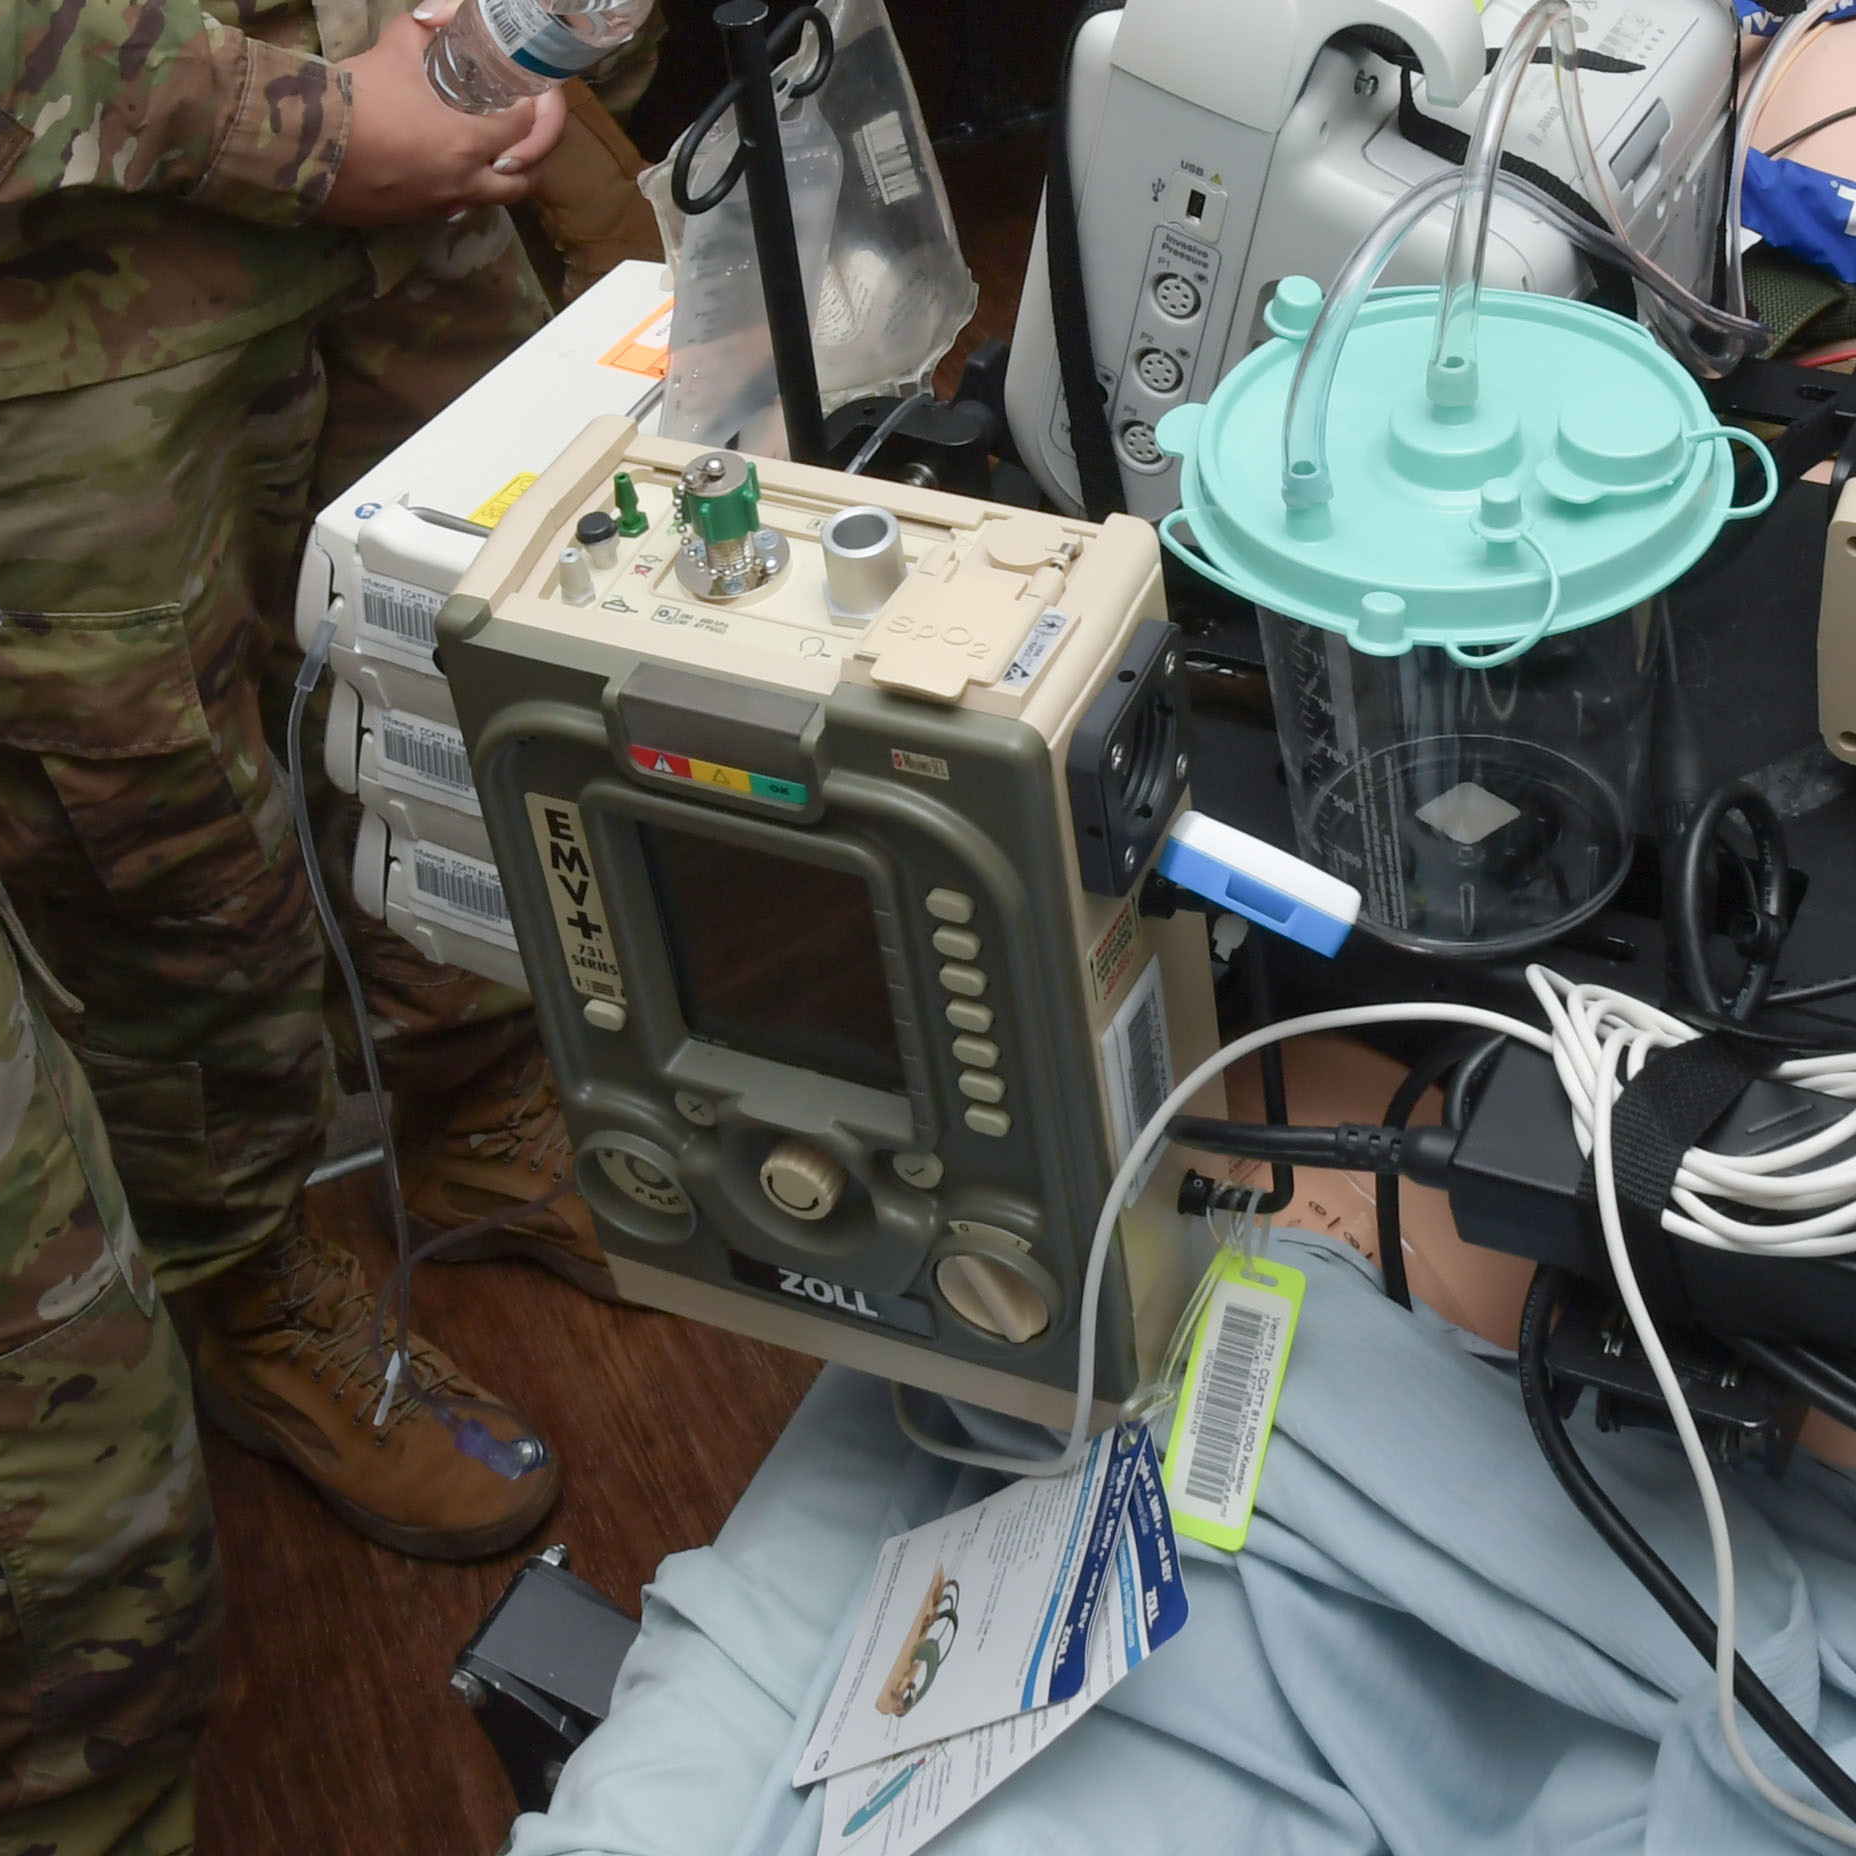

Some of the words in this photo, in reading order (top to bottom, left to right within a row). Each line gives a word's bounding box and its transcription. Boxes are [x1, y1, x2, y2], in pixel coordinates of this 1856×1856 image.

[1179, 159, 1204, 177] USB
[1160, 241, 1210, 270] Pressure
[1164, 232, 1210, 260] Invasive
[1156, 255, 1171, 270] P1
[1140, 330, 1154, 344] P2
[768, 784, 790, 796] OK
[571, 954, 618, 976] SERIES
[577, 944, 604, 960] 731
[778, 1267, 879, 1318] ZOLL
[1267, 1316, 1282, 1341] Vent
[1253, 1367, 1270, 1408] CCATT
[1243, 1426, 1257, 1453] MDG
[1234, 1455, 1250, 1496] Keesler
[1145, 1585, 1160, 1630] ZOLL
[1054, 1623, 1074, 1674] ZOLL
